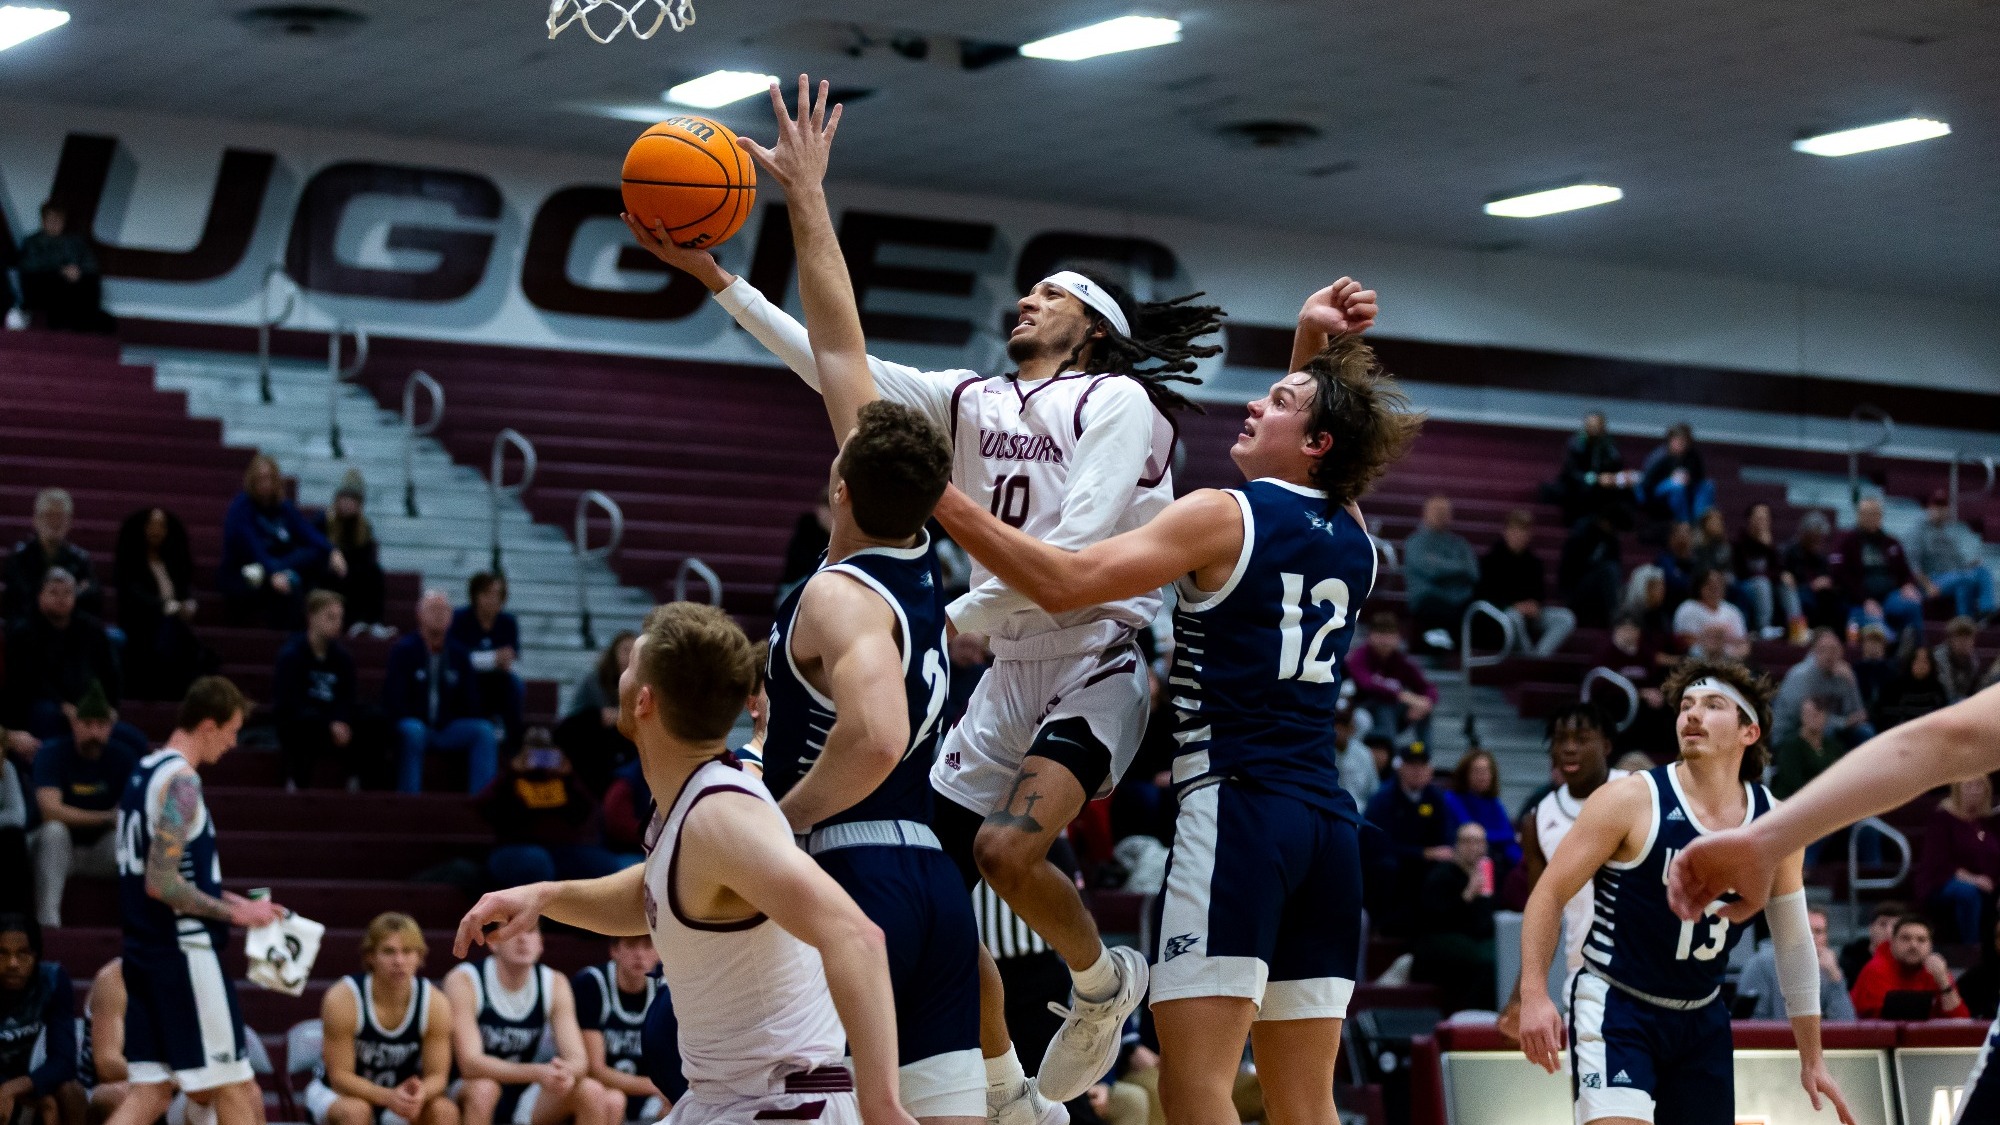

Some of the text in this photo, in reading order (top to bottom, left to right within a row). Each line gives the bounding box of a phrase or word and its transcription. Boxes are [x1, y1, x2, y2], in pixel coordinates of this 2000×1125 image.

[0, 134, 1178, 347] UGGIE
[979, 428, 1064, 464] UGSBUR
[991, 474, 1030, 529] 10
[1278, 572, 1350, 684] 12
[1676, 900, 1730, 961] 13
